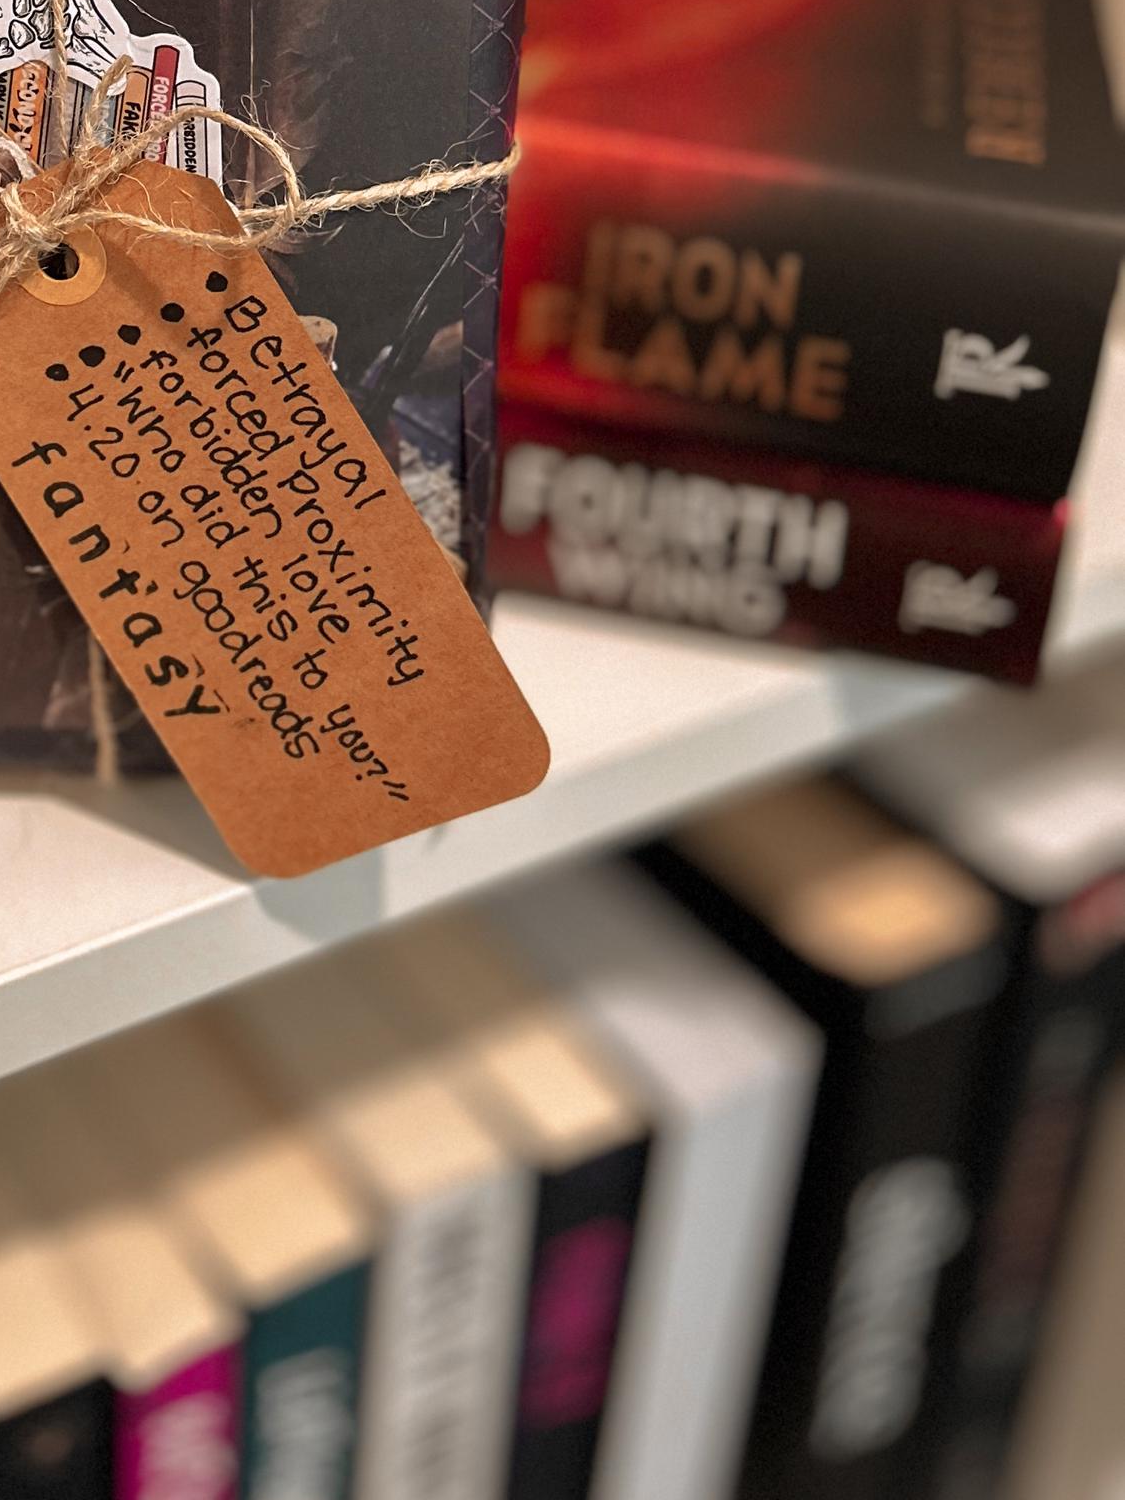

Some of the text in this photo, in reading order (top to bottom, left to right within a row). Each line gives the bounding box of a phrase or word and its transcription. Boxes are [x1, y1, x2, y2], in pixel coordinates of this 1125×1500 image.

[182, 116, 198, 174] RBIDDEN
[515, 278, 855, 426] FLAME
[580, 218, 803, 328] IRON
[139, 350, 351, 644] forbidden love
[186, 326, 424, 686] forced proximity
[224, 295, 386, 510] Betrayal
[11, 440, 221, 717] fantasy
[67, 383, 321, 759] 4.20 on goodreads
[180, 484, 250, 550] did
[232, 555, 299, 642] this
[292, 648, 328, 690] to
[500, 440, 850, 592] FOURTH
